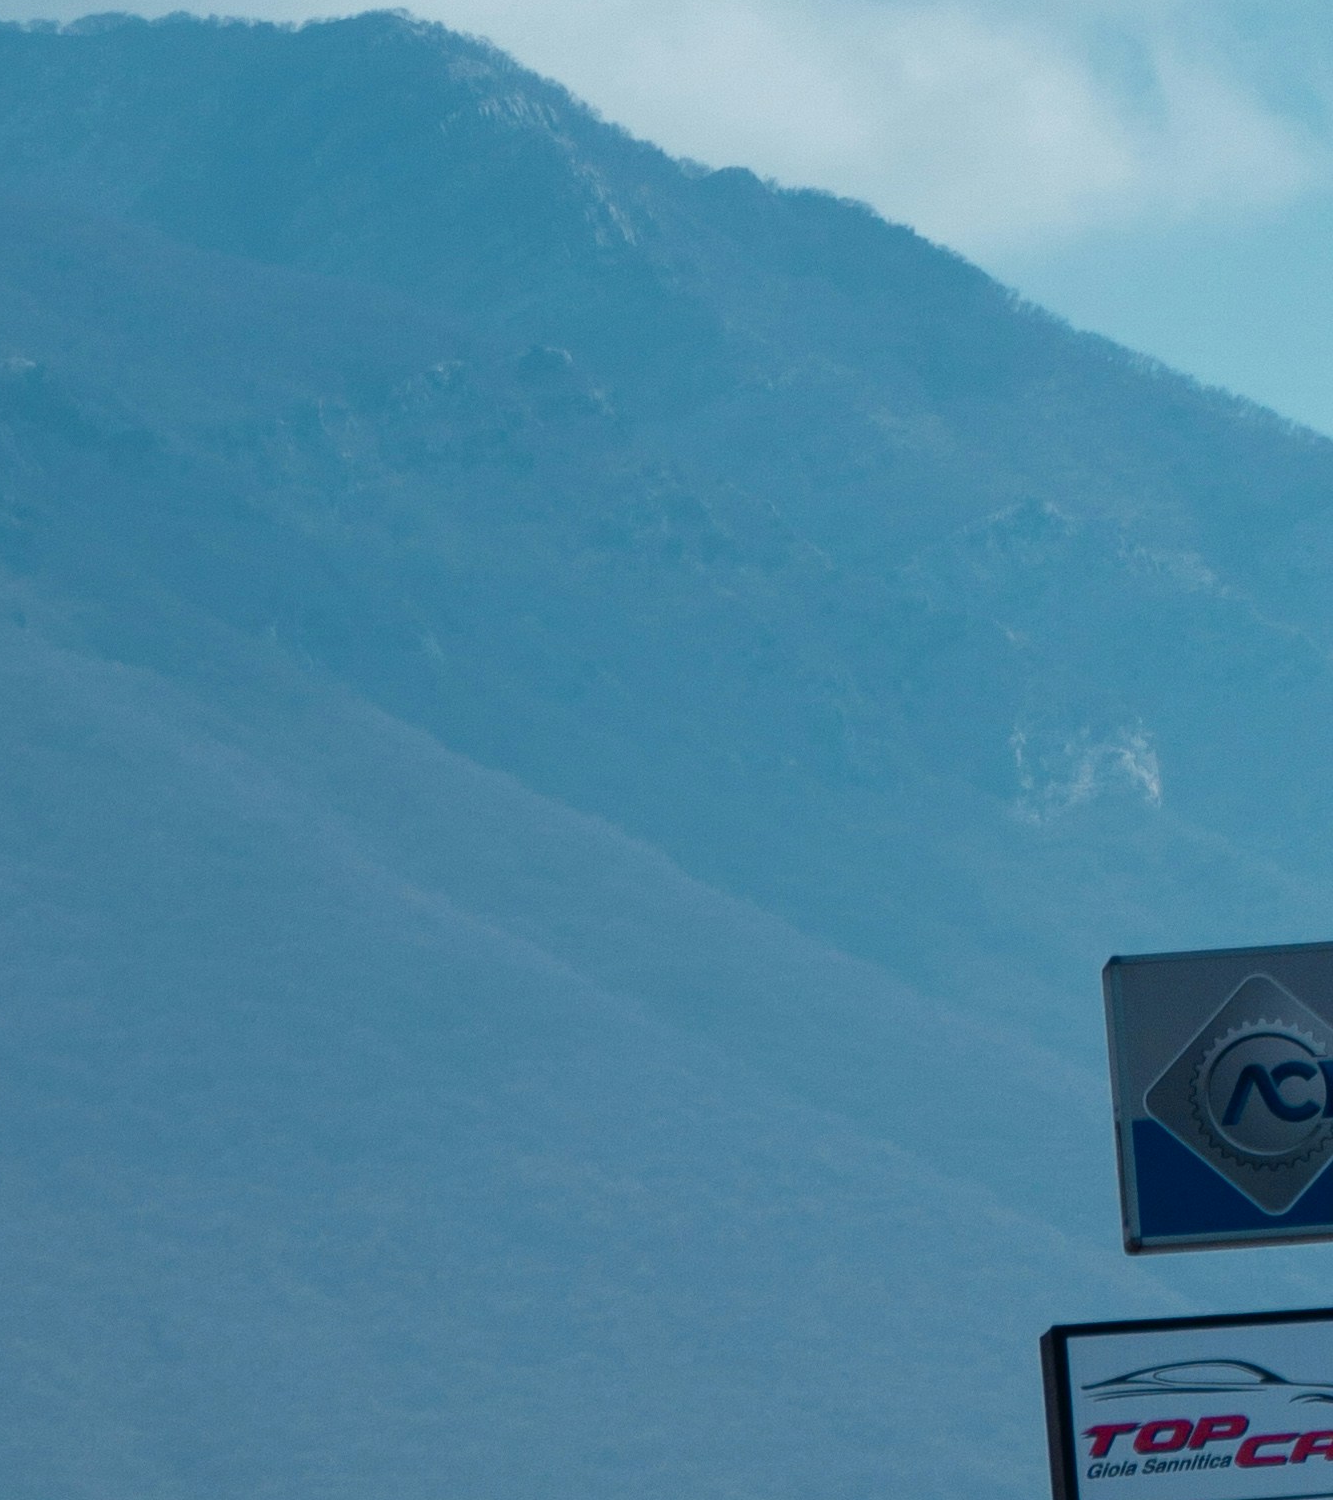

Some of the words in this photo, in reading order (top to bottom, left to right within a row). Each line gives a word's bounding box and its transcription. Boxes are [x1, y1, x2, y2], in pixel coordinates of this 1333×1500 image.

[1081, 1414, 1249, 1458] TOP
[1087, 1459, 1137, 1480] Gioia
[1141, 1453, 1232, 1475] Sannitica
